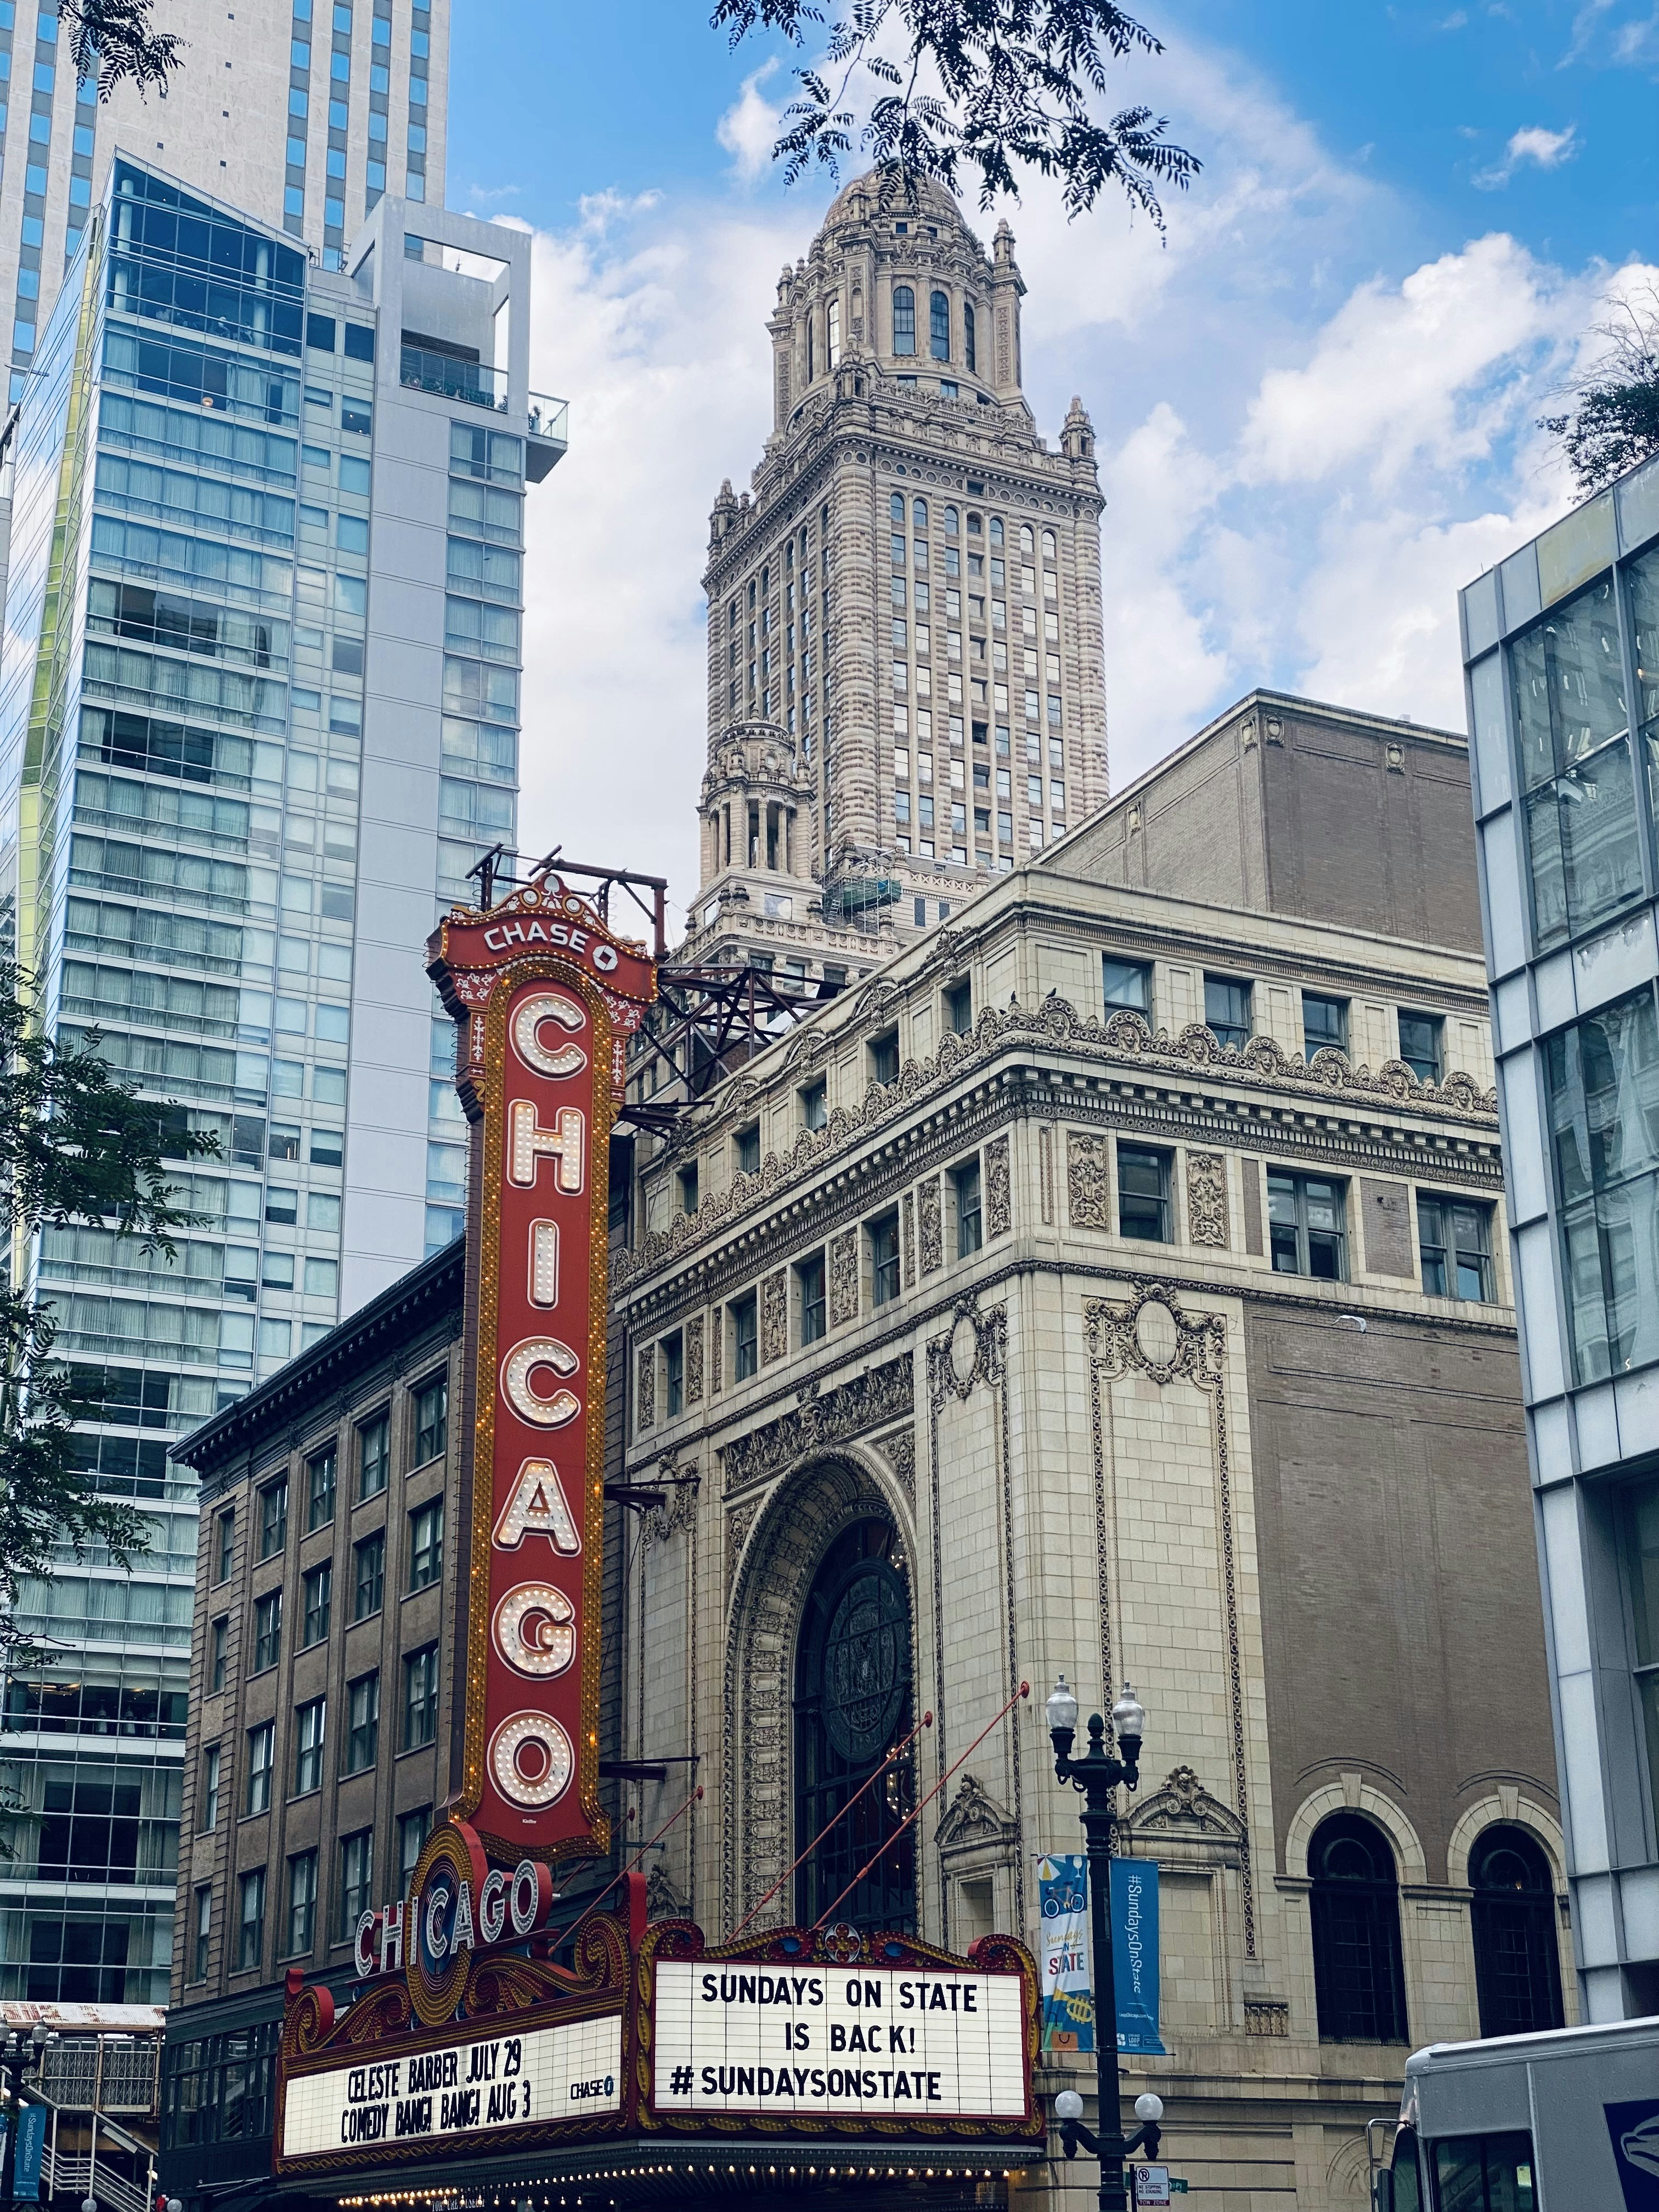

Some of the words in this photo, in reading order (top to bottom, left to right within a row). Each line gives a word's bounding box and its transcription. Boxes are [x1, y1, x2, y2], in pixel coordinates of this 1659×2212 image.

[483, 921, 590, 953] CHASE
[486, 992, 588, 1813] CHICAGO
[354, 1859, 539, 1977] CHICAGO
[1125, 1875, 1143, 1994] #SundaysOnState
[1048, 1952, 1084, 1975] STATE
[701, 1973, 823, 2006] SUNDAYS
[846, 1979, 881, 2008] ON
[900, 1982, 977, 2012] STATE
[785, 2022, 810, 2051] IS
[831, 2025, 915, 2053] BACK!
[348, 2062, 400, 2103] CELESTE
[408, 2051, 458, 2094] BARBER
[466, 2042, 500, 2084] JULY
[504, 2038, 522, 2077] 29
[571, 2079, 603, 2100] CHASE
[341, 2103, 389, 2143] COMEDY
[395, 2096, 432, 2136] BANG!
[441, 2089, 480, 2130] BANG!
[487, 2081, 517, 2124] AUG
[522, 2080, 531, 2118] 3
[431, 2199, 458, 2211] TORURE
